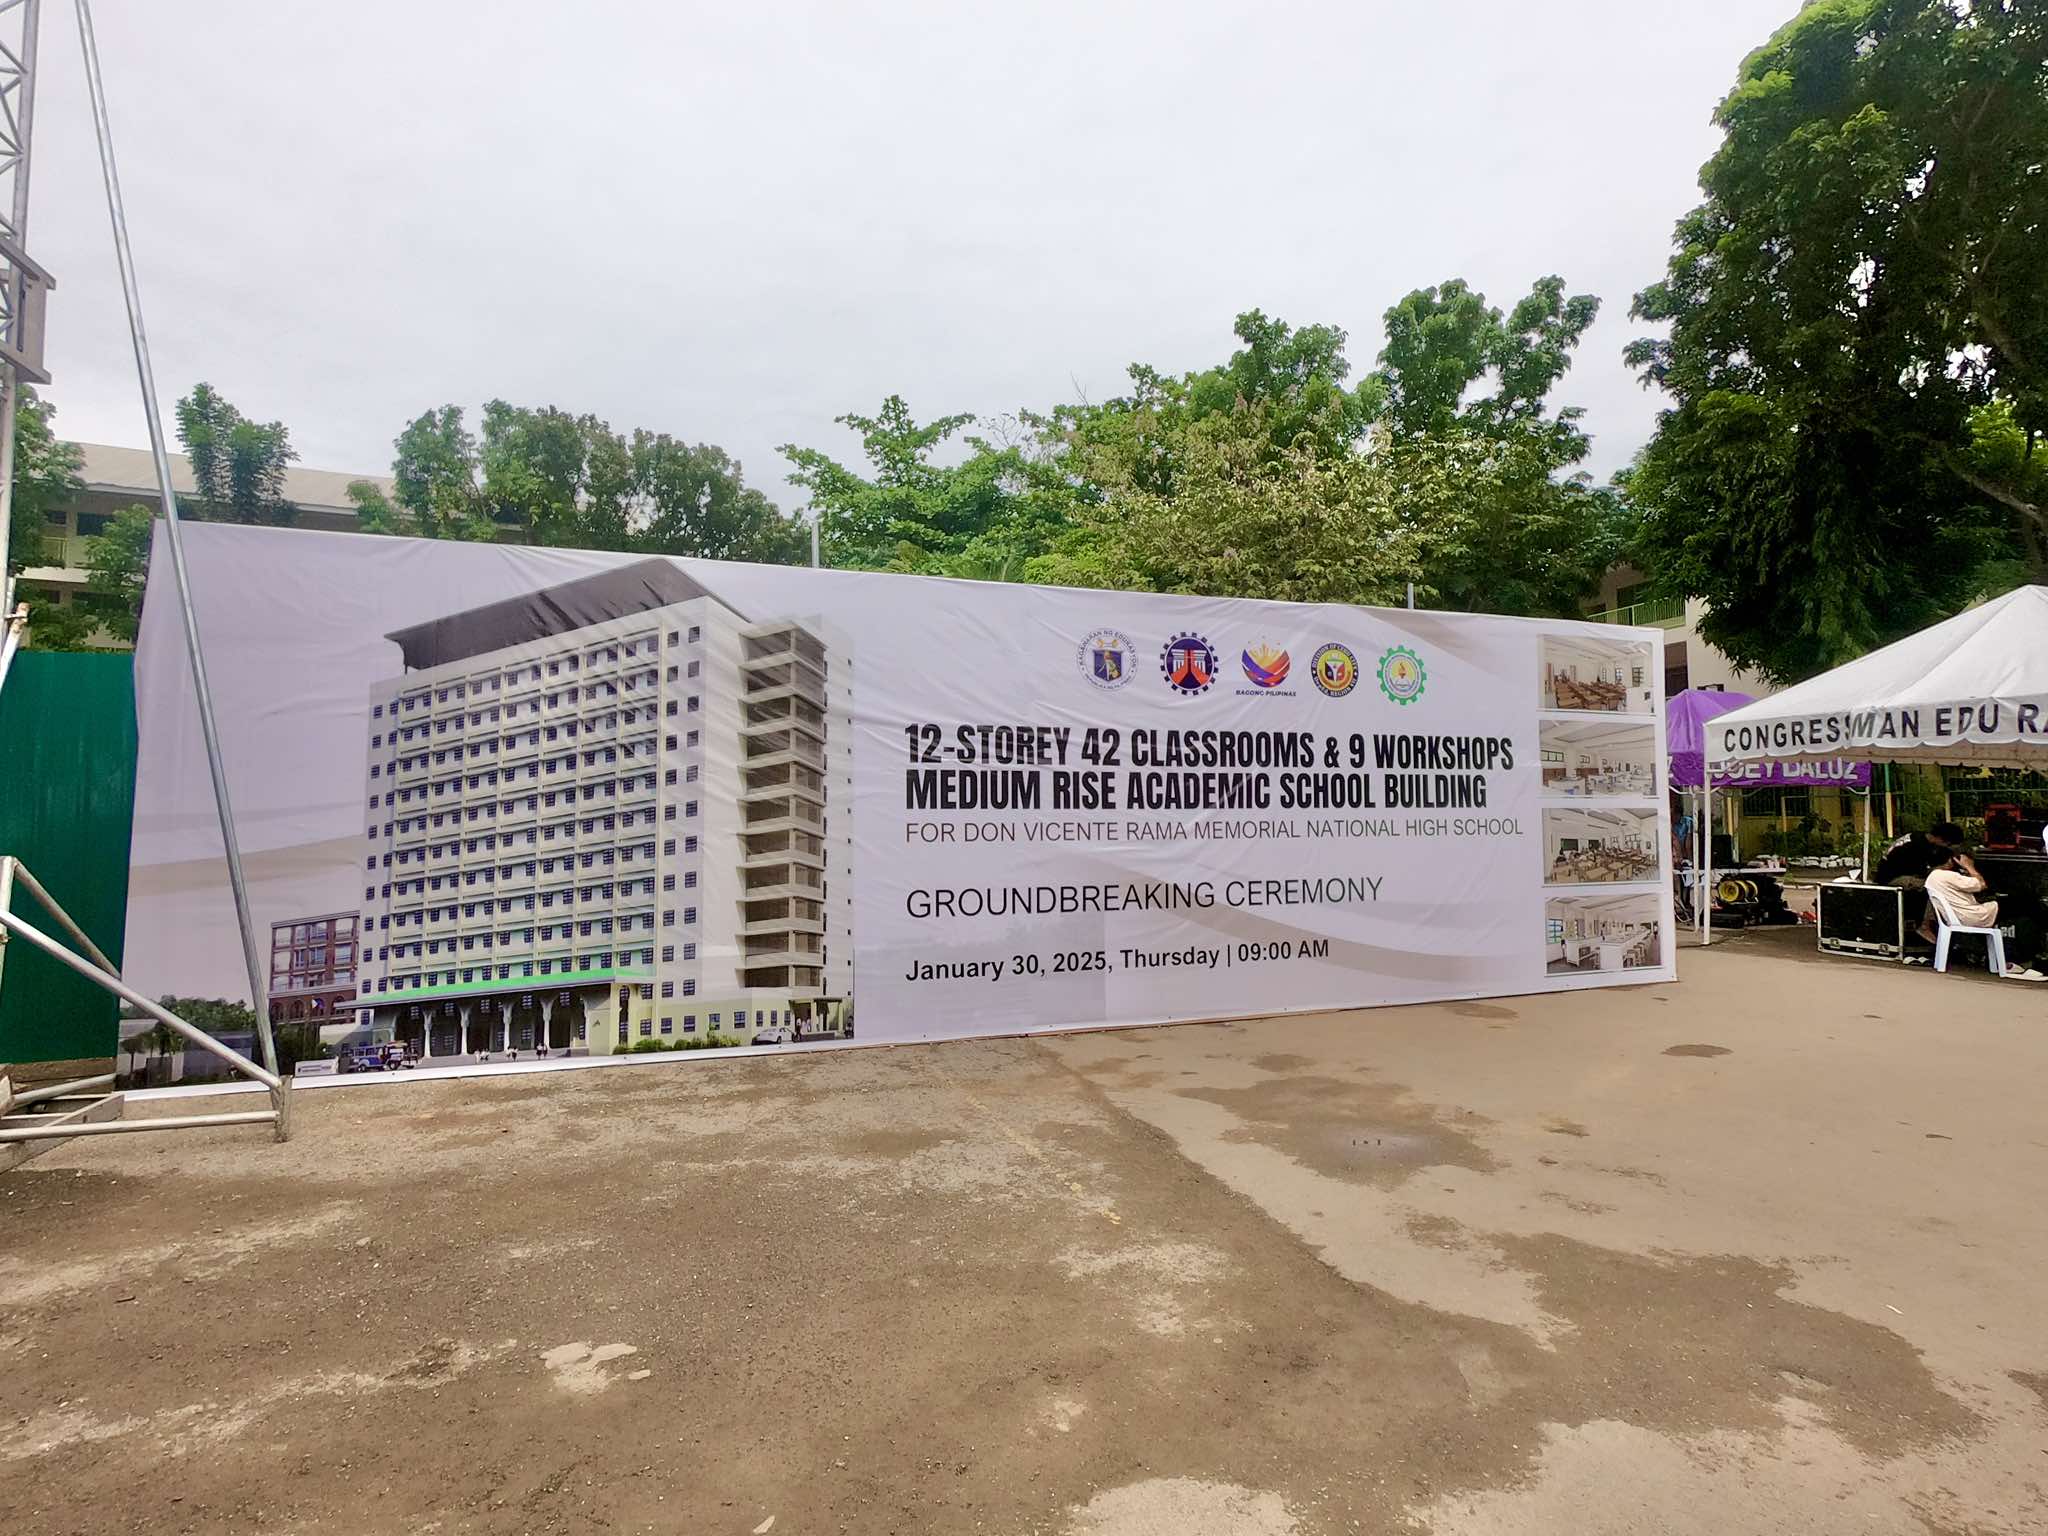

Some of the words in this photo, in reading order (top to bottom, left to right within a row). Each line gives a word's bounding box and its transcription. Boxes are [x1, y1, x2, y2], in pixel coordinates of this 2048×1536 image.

[1936, 702, 2000, 737] EDU
[904, 723, 1072, 765] 12-STOREY
[1081, 728, 1121, 766] 42
[1131, 729, 1314, 768] CLASSROOMS
[1324, 736, 1340, 768] &
[1349, 733, 1366, 769] 9
[1373, 734, 1515, 771] WORKSHOPS
[906, 769, 1041, 810] MEDIUM
[1053, 771, 1116, 810] RISE
[1127, 772, 1270, 810] ACADEMIC
[1280, 773, 1376, 809] SCHOOL
[1385, 774, 1487, 809] BUILDING
[906, 822, 955, 843] FOR
[964, 822, 1015, 842] DON
[1024, 822, 1119, 841] VICENTE
[1127, 821, 1187, 840] RAMA
[1194, 820, 1301, 840] MEMORIAL
[1307, 819, 1400, 838] NATIONAL
[1406, 818, 1447, 836] HIGH
[1453, 818, 1524, 836] SCHOOL
[907, 881, 1215, 919] GROUNDBREAKING
[1226, 876, 1384, 907] CEREMONY
[906, 959, 1004, 982] January
[1012, 954, 1047, 977] 30,
[1053, 951, 1113, 974] 2025,
[1120, 946, 1220, 969] Thursday
[1238, 942, 1291, 962] 09:00
[1298, 939, 1329, 959] AM
